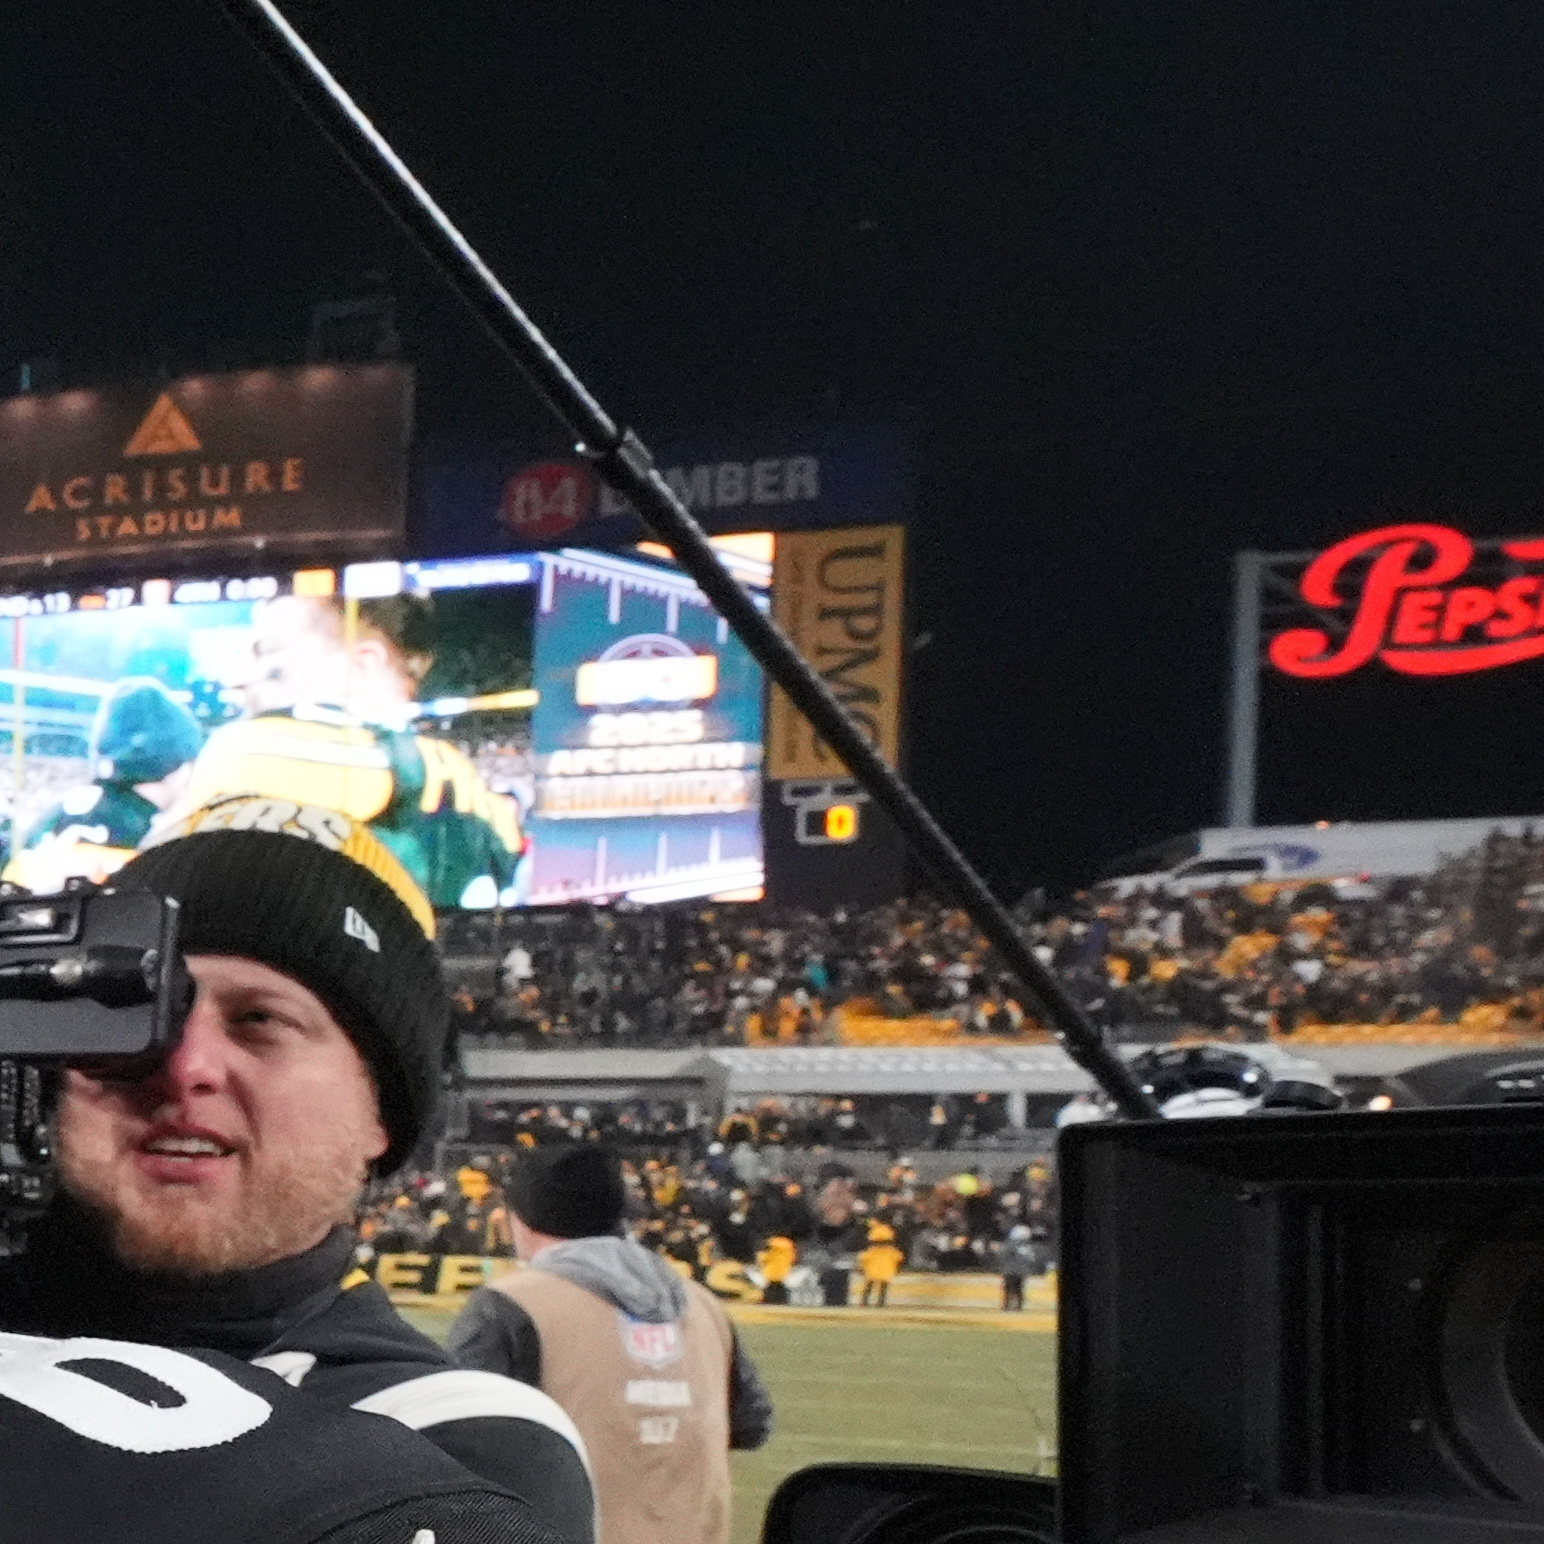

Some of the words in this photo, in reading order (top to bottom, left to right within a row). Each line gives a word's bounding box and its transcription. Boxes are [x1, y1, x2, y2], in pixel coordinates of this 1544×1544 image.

[25, 457, 305, 513] ACRISURE
[600, 455, 820, 518] LMBER
[75, 506, 242, 541] STADIUM
[588, 709, 704, 747] 2025
